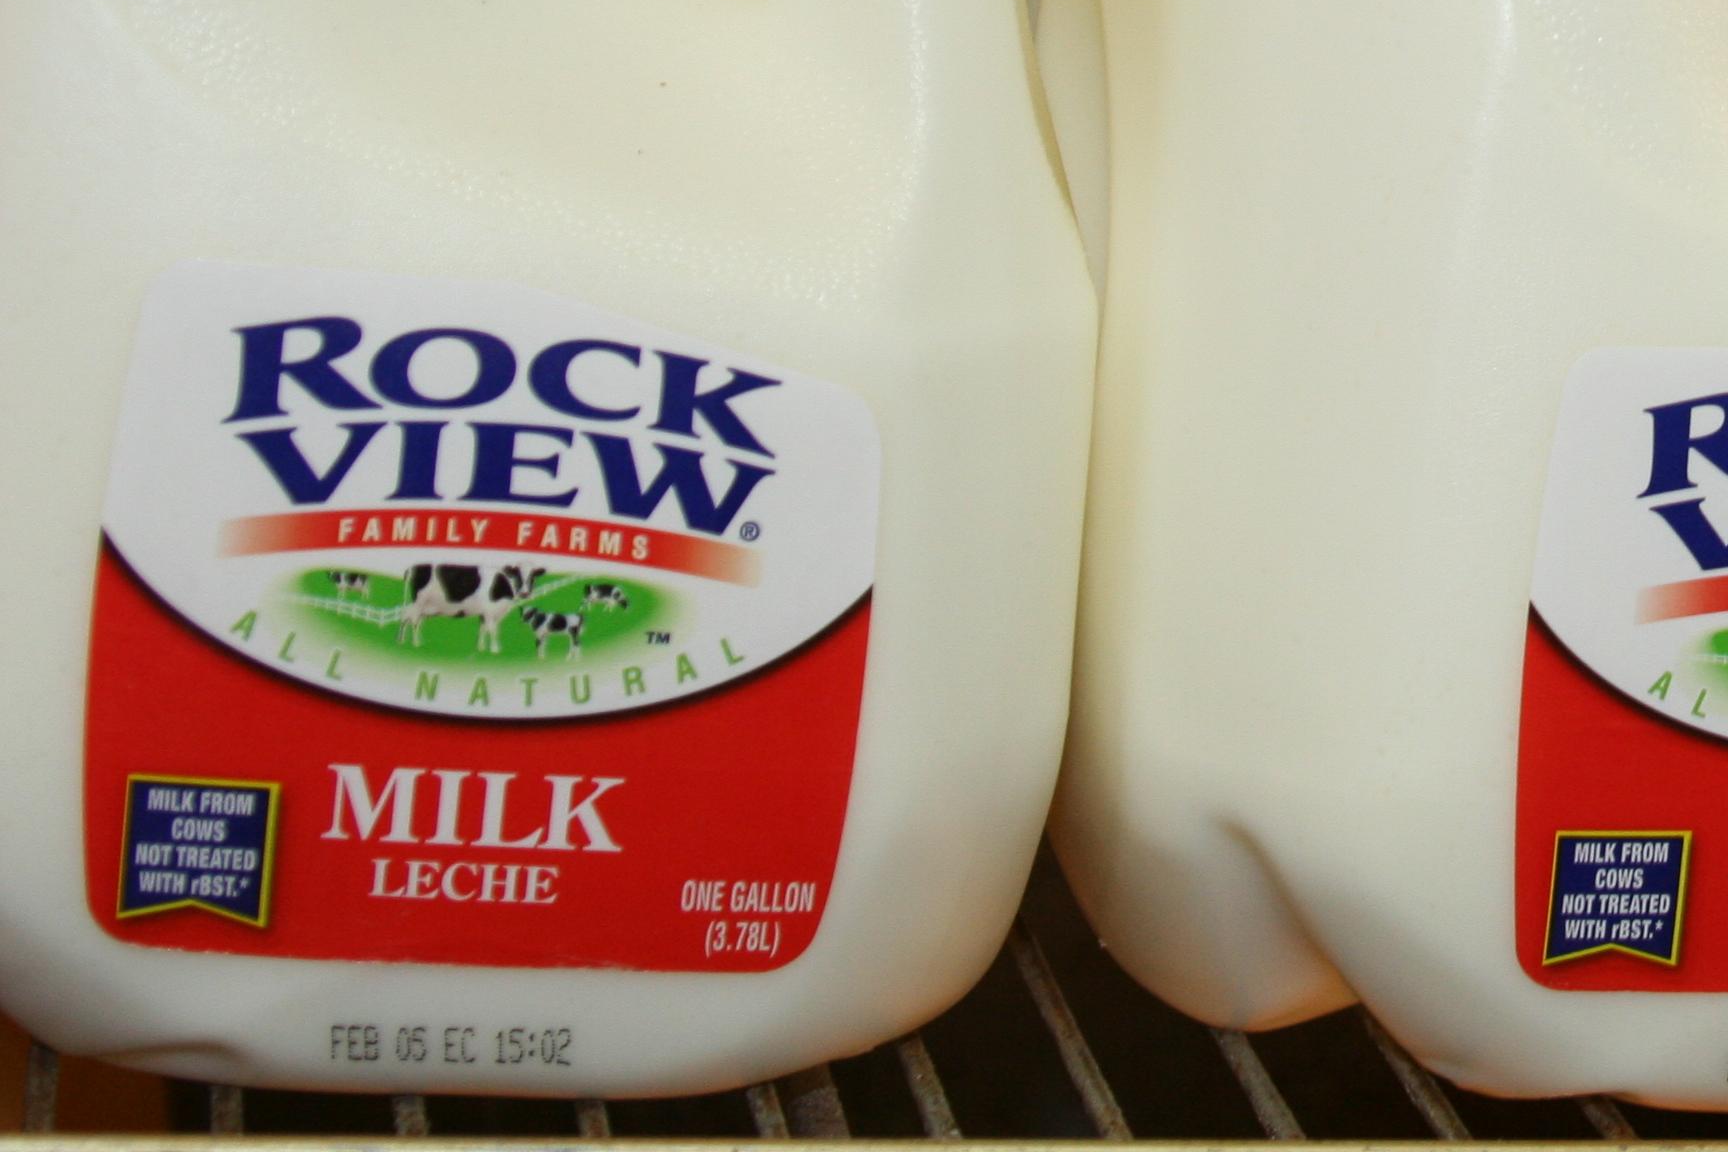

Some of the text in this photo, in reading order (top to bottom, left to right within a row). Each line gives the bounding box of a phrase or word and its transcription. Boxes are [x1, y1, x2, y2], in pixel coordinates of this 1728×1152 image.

[220, 315, 783, 460] ROCK
[233, 419, 777, 538] VIEW
[337, 517, 652, 560] FAMILY FARMS
[228, 609, 746, 708] ALL NATURAL
[147, 788, 255, 816] MILK FROM
[320, 763, 626, 853] MILK
[171, 817, 227, 842] COWS
[135, 843, 257, 871] NOT TREATED
[1574, 842, 1669, 864] MILK FROM
[139, 870, 186, 894] WITH
[368, 858, 562, 906] LECHE
[1595, 868, 1644, 889] COWS
[681, 879, 816, 913] ONE GALLON
[1562, 894, 1671, 915] NOT TREATED
[705, 920, 781, 958] (3.78L)
[1565, 919, 1606, 939] WITH
[331, 1025, 571, 1066] FEB 05 EC 15:02
